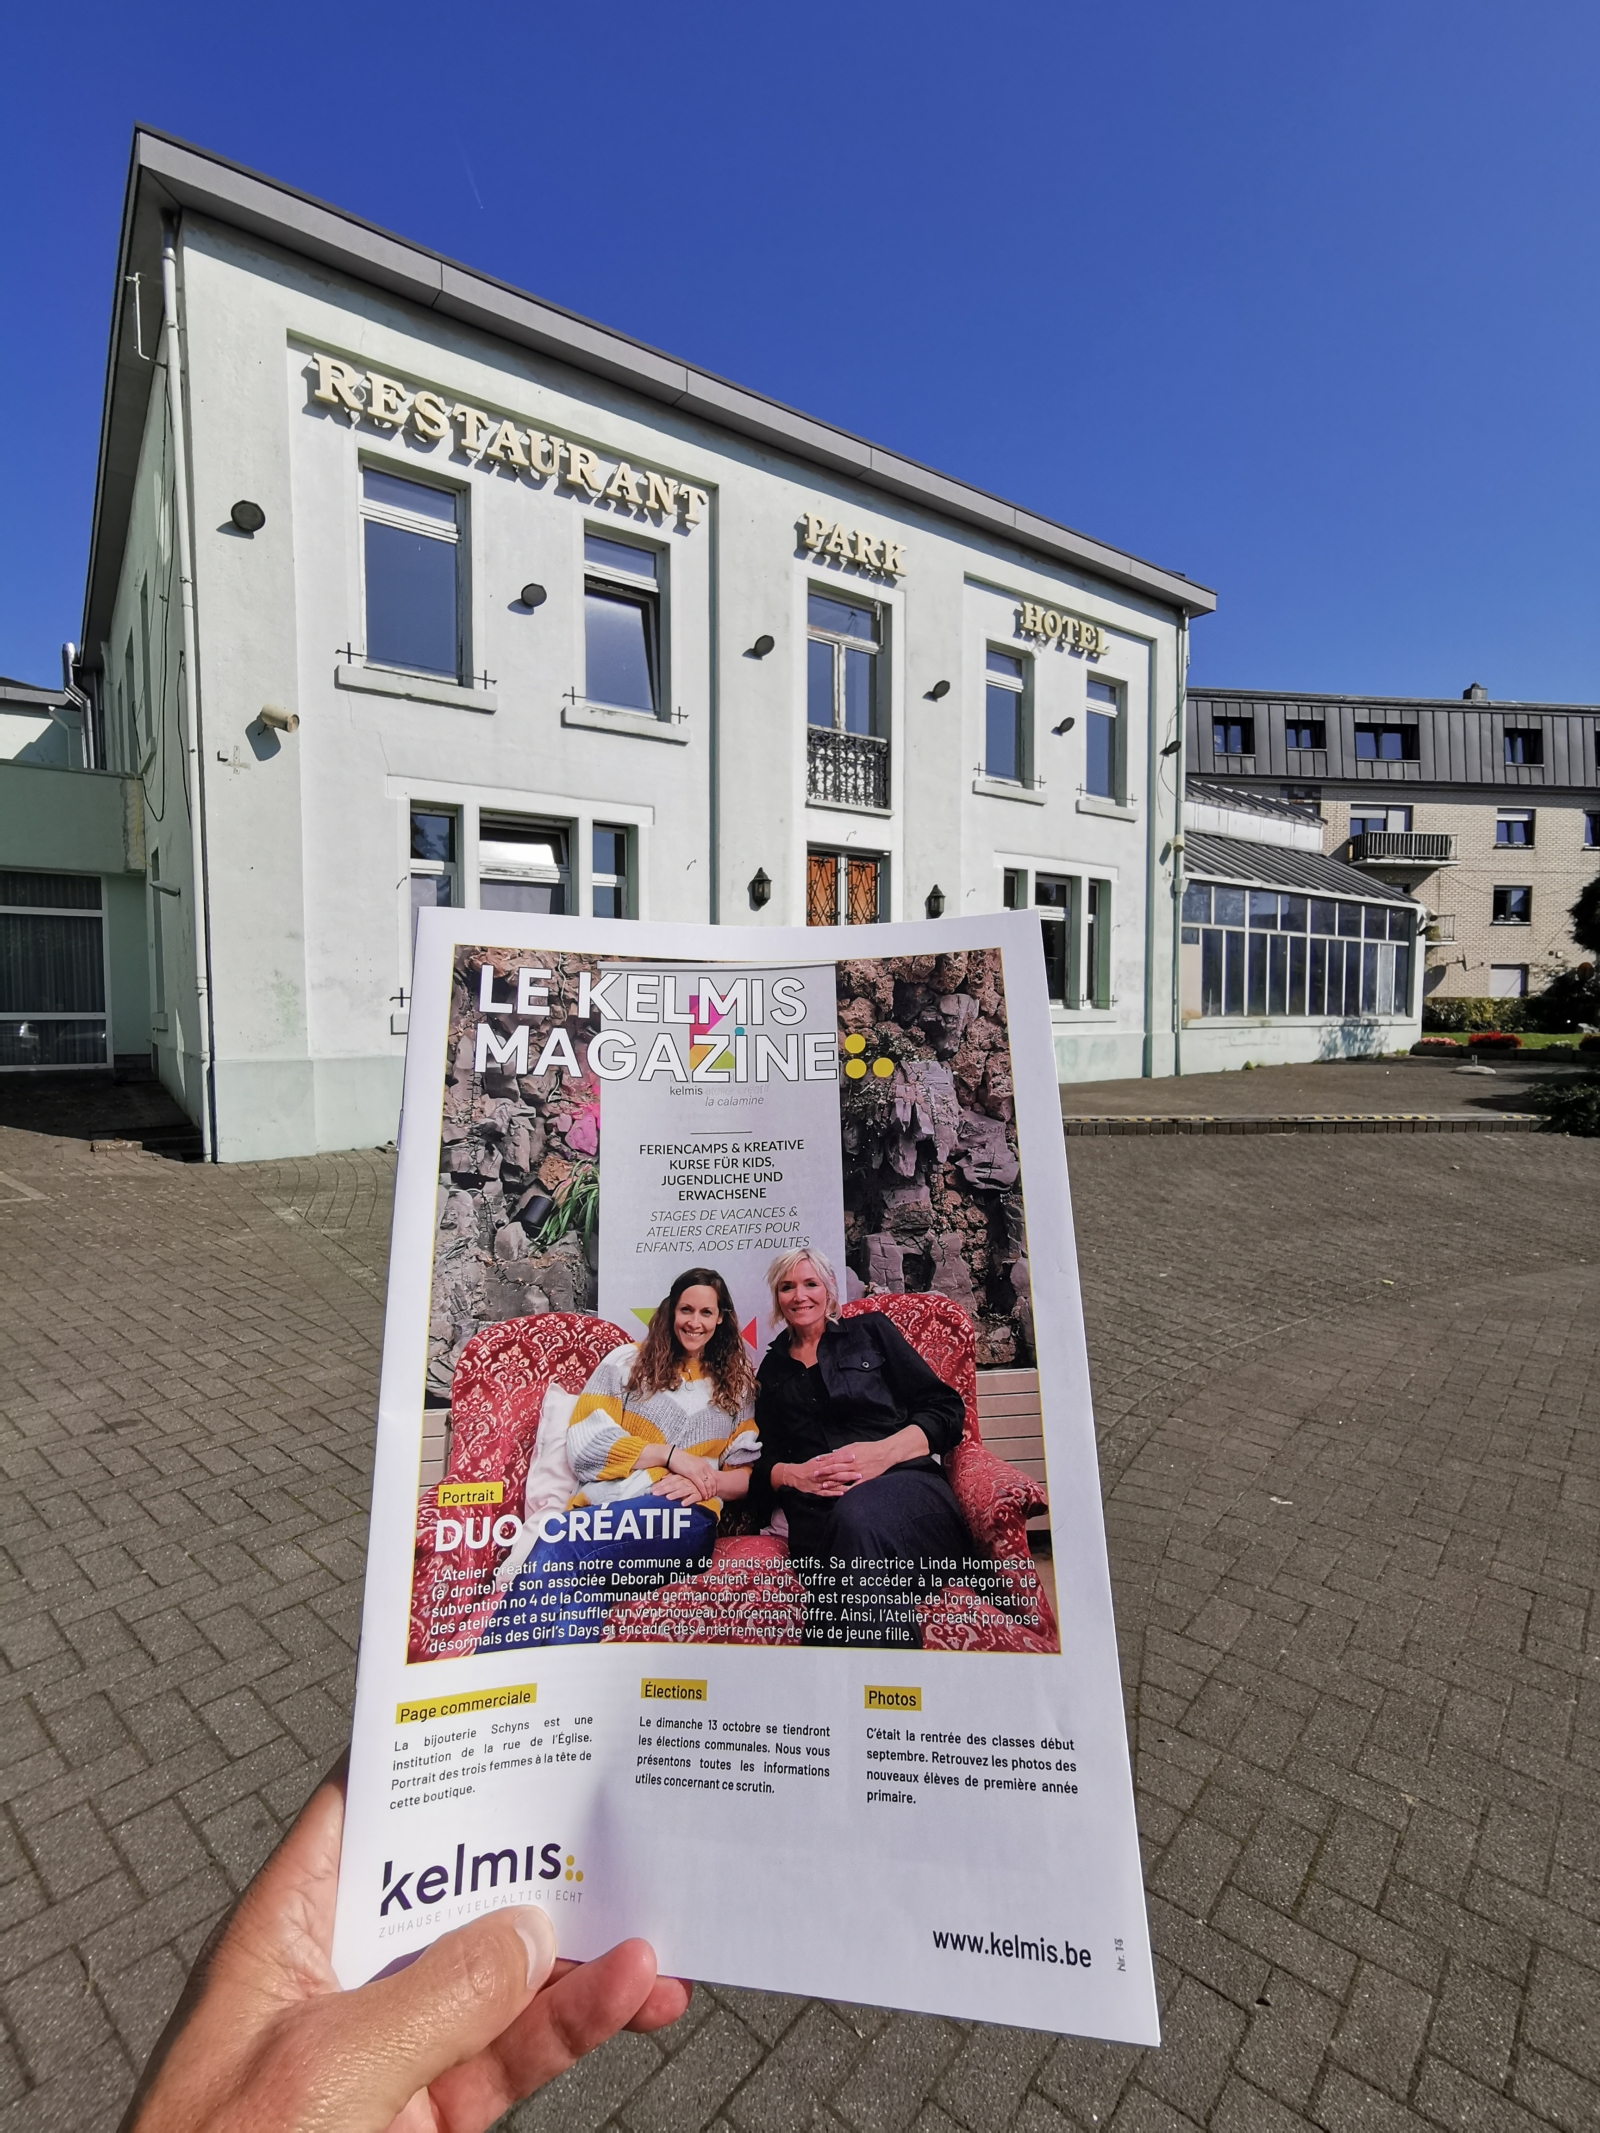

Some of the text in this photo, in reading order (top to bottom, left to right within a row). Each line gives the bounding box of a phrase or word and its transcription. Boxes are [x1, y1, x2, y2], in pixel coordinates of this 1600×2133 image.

[313, 352, 708, 524] RESTAURANT
[804, 512, 907, 576] PARK
[1021, 602, 1110, 655] HOTEL
[479, 964, 806, 1026] LE KELMIS
[474, 1024, 837, 1082] MAGAZINE
[670, 1086, 703, 1095] kelmis
[705, 1096, 764, 1106] la calamine
[639, 1139, 804, 1154] FERIENCAMPS & KREATIVE
[669, 1159, 710, 1170] KURSE
[714, 1157, 738, 1169] FÜR
[662, 1171, 783, 1186] JUGENDLICHE UND
[678, 1188, 766, 1201] ERWACHSENE
[651, 1206, 798, 1221] STAGES DE VACANCES &
[647, 1222, 800, 1237] ATELIERS CREATIFS POUR
[636, 1236, 810, 1253] ENFANTS, ADOS ET ADULTES
[443, 1490, 494, 1504] Portrait
[435, 1503, 692, 1552] DUO CRÉATIF
[435, 1557, 1035, 1583] L'Atelier créatif dans notre commune grands objectifs. Sa directrice Linda Hompesch
[431, 1571, 1013, 1601] (à droite) son associée Deborah Dütz veulent élargir l'offre accéder catégorie
[431, 1590, 1037, 1619] subvention Communauté germanophone. Deborah est responsable l'organisation
[431, 1607, 1038, 1635] des ateliers insuffler vent nouveau concernant l'offre. Ainsi, l'Atelier créatif propose
[429, 1622, 914, 1653] désormais des Girl's Days encadre des enterrements vie jeune fille.
[645, 1682, 702, 1699] Élections
[869, 1691, 916, 1706] Photos
[400, 1691, 531, 1722] Page commerciale
[394, 1716, 593, 1751] La bijouterie Schyns est une
[640, 1717, 830, 1737] Le dimanche 13 octobre se tiendront
[867, 1727, 1074, 1750] C'était la rentrée des classes début
[393, 1731, 592, 1771] institution de la rue de l'Église.
[639, 1736, 830, 1756] les élections communales. Nous vous
[391, 1751, 591, 1790] Portrait des trois femmes à la tête de
[637, 1754, 830, 1777] présentons toutes les informations
[867, 1749, 1076, 1772] septembre. Retrouvez les photos des
[636, 1774, 775, 1794] utiles concernant ce scrutin.
[867, 1770, 1078, 1794] nouveaux élèves de première année
[390, 1785, 475, 1810] cette boutique.
[867, 1790, 916, 1804] primaire.
[380, 1843, 561, 1916] kelmis
[379, 1911, 441, 1938] ZUHAUSE
[555, 1889, 583, 1903] ECHT
[933, 1930, 1091, 1968] www.kelmis.be
